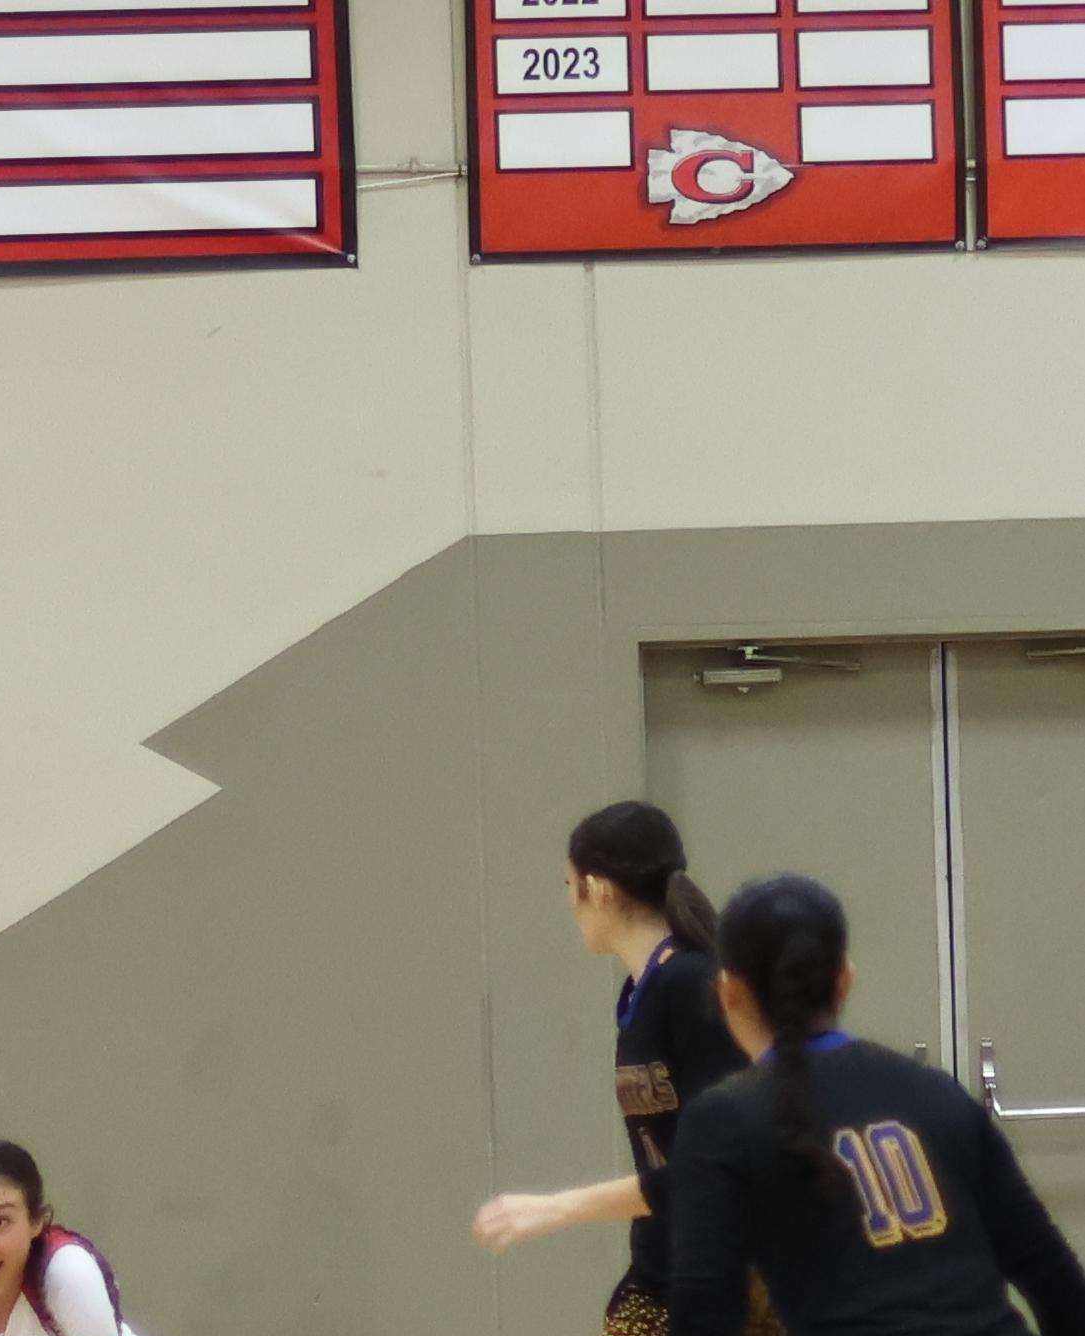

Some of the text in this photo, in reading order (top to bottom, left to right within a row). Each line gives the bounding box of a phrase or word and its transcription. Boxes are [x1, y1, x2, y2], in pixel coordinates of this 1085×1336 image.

[522, 47, 600, 80] 2023
[671, 149, 755, 204] C
[834, 1120, 948, 1248] 10
